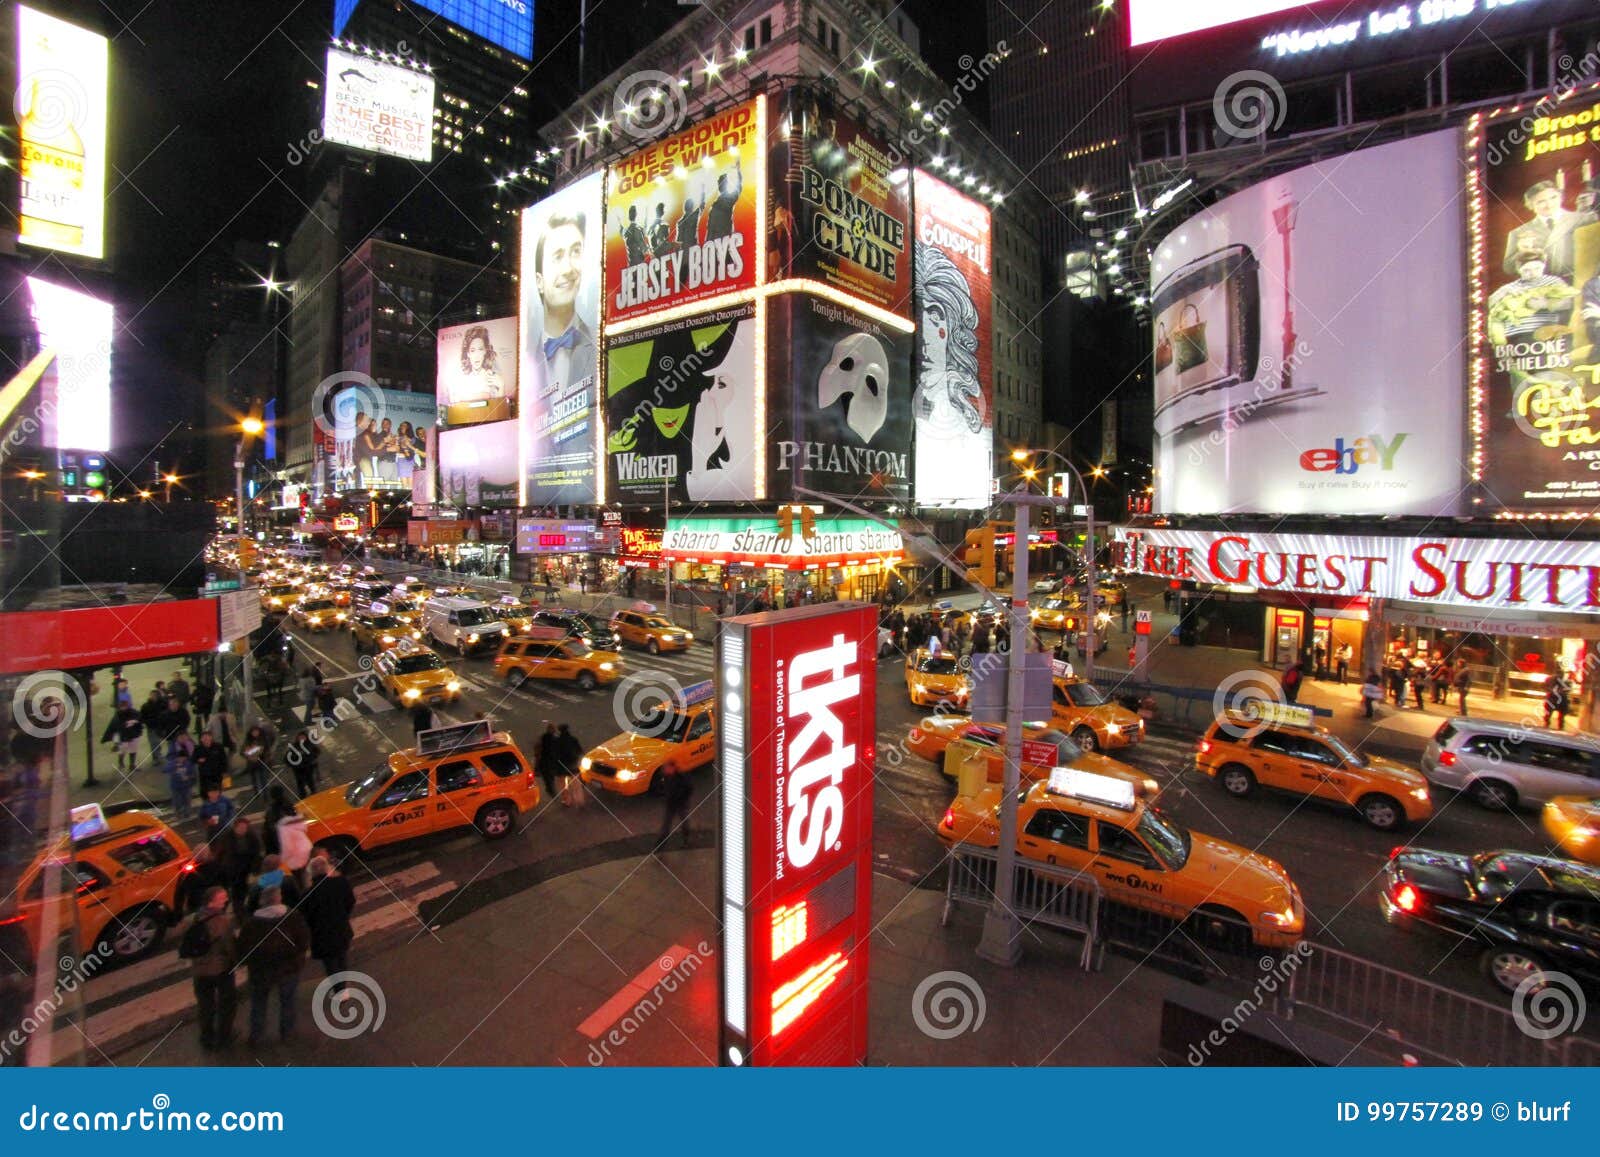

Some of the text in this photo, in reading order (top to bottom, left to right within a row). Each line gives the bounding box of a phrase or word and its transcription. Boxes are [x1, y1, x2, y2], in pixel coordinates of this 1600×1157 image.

[1367, 5, 1411, 36] let
[336, 91, 366, 104] BEST
[335, 115, 425, 143] MUSICAL OF
[336, 102, 425, 134] THE BEST
[663, 108, 750, 158] CROWD
[335, 126, 424, 152] THIS CENTURY
[618, 158, 675, 194] GOES
[800, 165, 904, 253] BONNIE
[814, 211, 897, 283] CLYDE
[616, 232, 743, 310] JERSEY BOYS
[810, 298, 842, 322] Tonight
[843, 309, 872, 334] belongs
[1495, 339, 1567, 359] BROOKE
[1496, 353, 1571, 373] SHIELDS
[776, 440, 907, 479] PHANTOM
[431, 528, 462, 541] GIFTS
[670, 525, 899, 554] sbarro sbarro sbarro sbarro
[1208, 534, 1388, 594] GUEST
[776, 670, 784, 715] service
[776, 716, 785, 728] of
[776, 729, 786, 776] Theatre
[393, 810, 425, 824] TAXI
[775, 777, 786, 850] Development
[775, 851, 785, 881] Fund
[1127, 873, 1163, 893] TAXI
